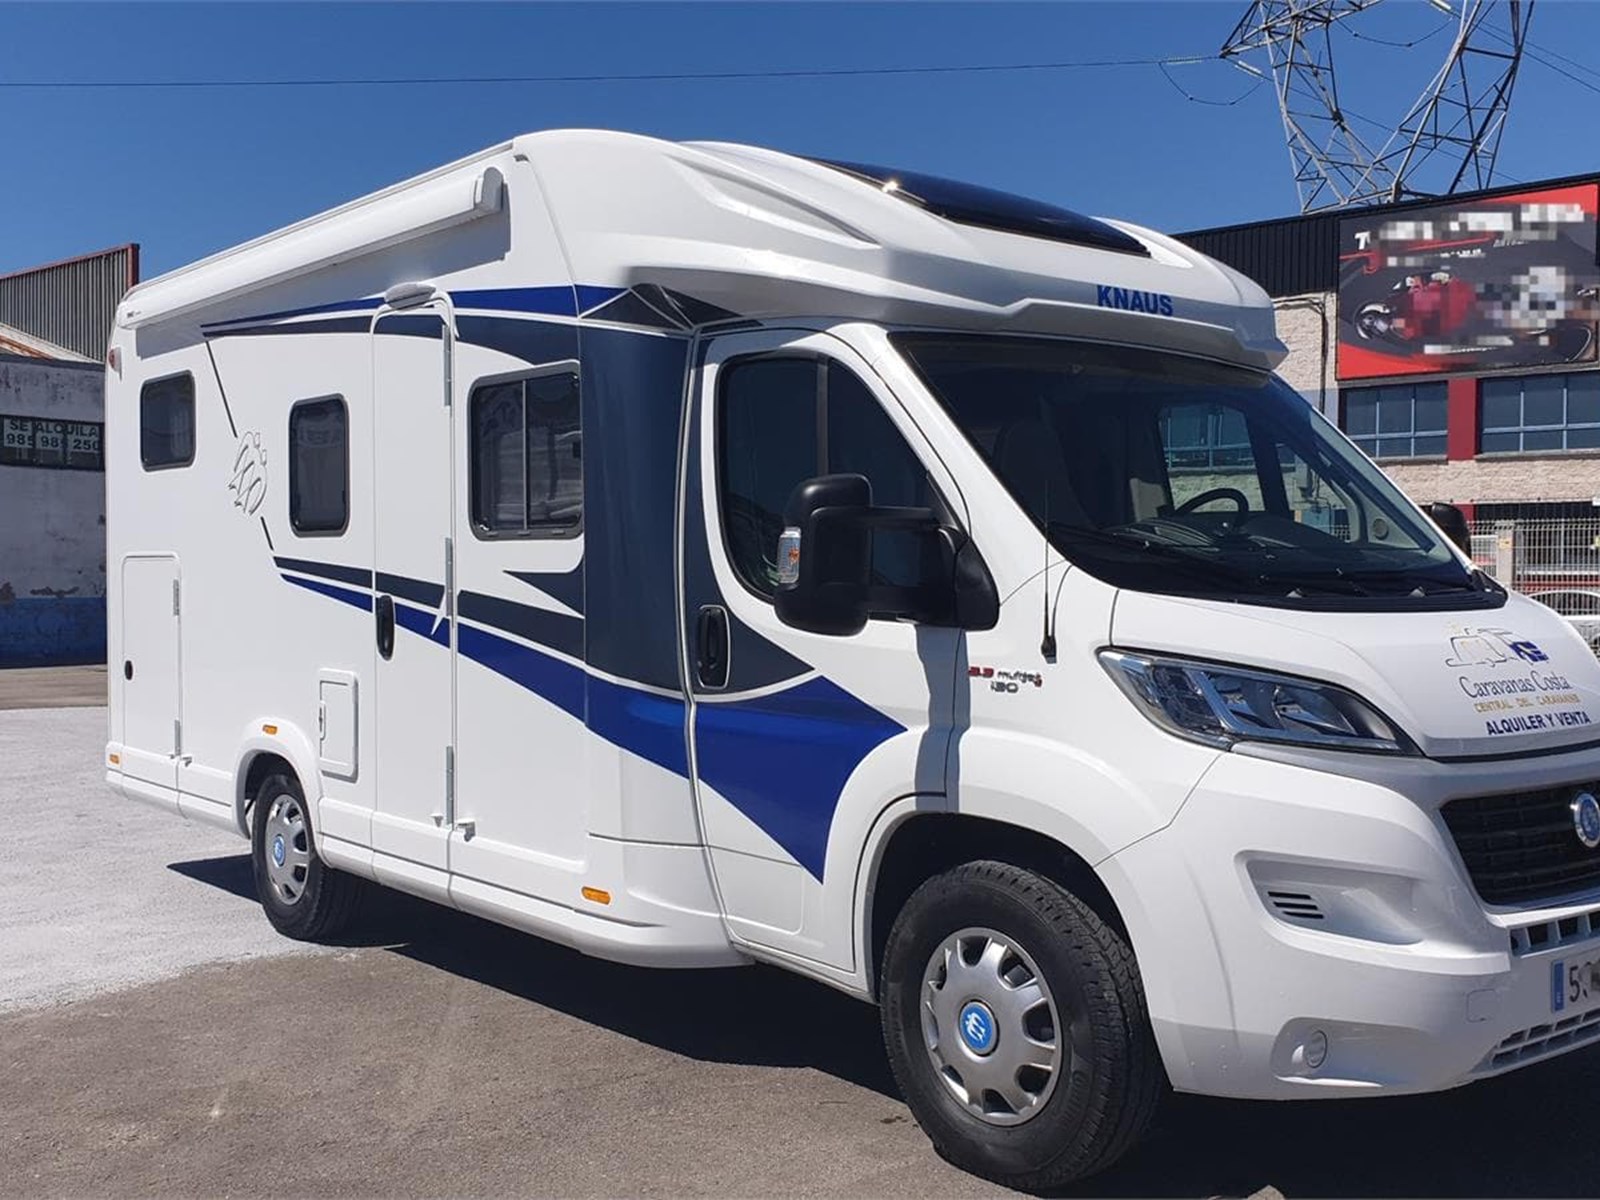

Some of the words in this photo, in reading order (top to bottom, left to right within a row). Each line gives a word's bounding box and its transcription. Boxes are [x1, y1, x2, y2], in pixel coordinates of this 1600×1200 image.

[1097, 284, 1173, 317] KNAUS
[10, 419, 29, 432] SE
[35, 421, 97, 437] ALQUILA
[1460, 676, 1536, 698] Caravanas
[1530, 670, 1573, 691] Costa
[1486, 714, 1547, 735] ALQUILER
[1545, 714, 1556, 727] Y
[1554, 711, 1592, 726] VENTA
